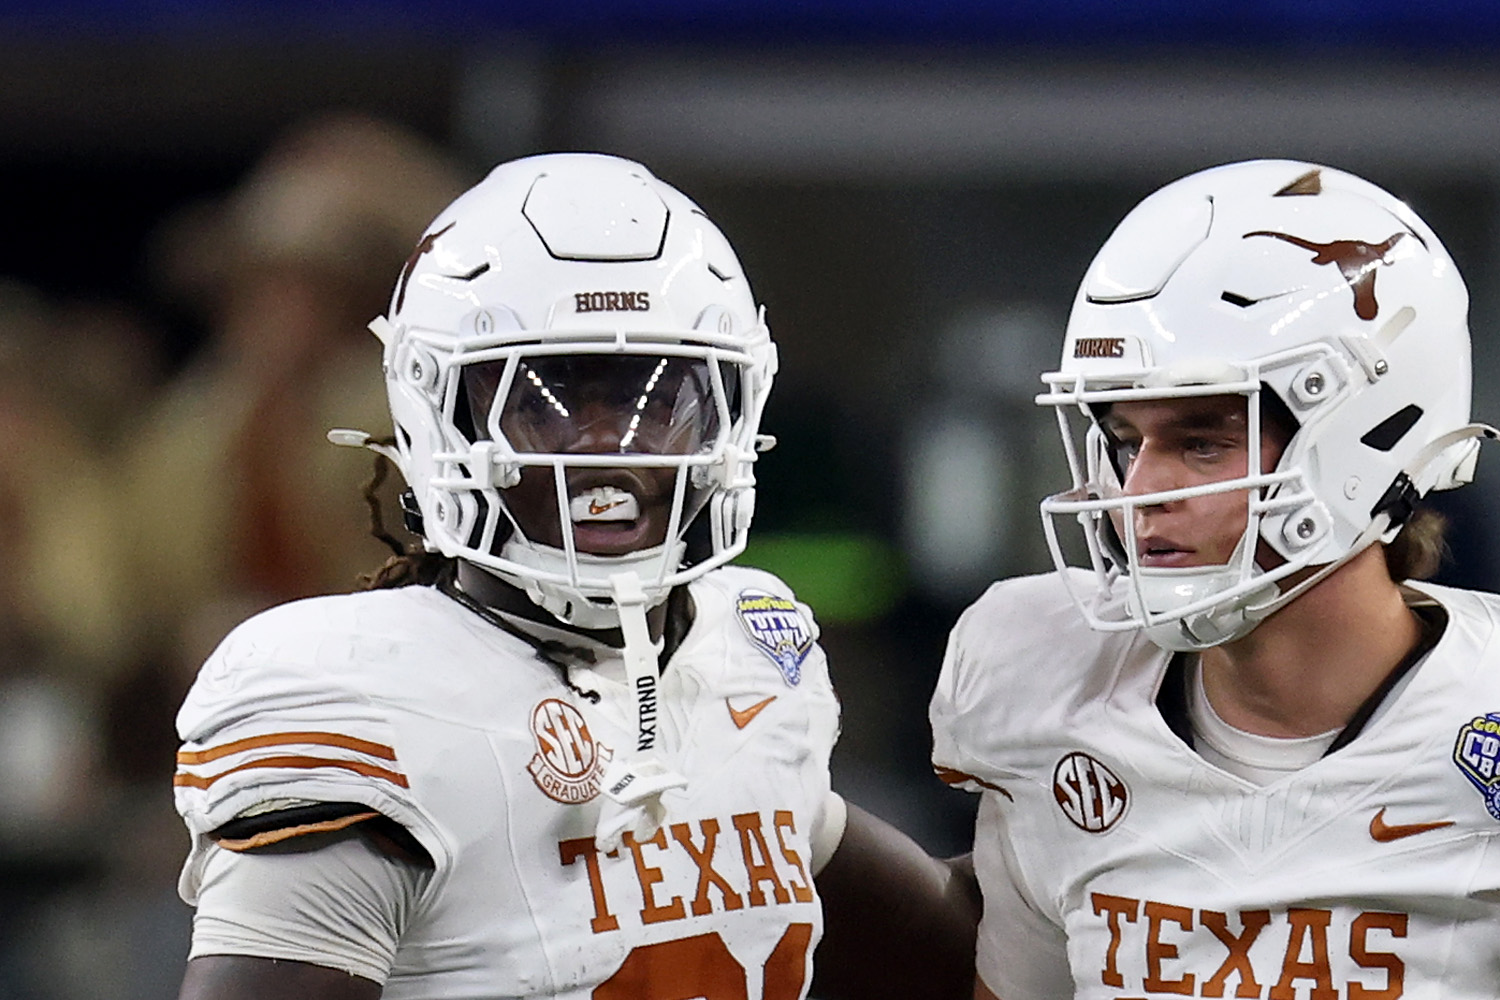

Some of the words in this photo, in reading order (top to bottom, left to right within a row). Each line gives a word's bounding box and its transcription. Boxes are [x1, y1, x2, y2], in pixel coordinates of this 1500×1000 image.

[575, 292, 650, 313] HORNS
[1074, 338, 1125, 358] HORNS
[534, 700, 594, 777] SEC
[636, 675, 657, 751] NXTRND
[1055, 753, 1126, 832] SEC
[558, 810, 813, 934] TEXAS
